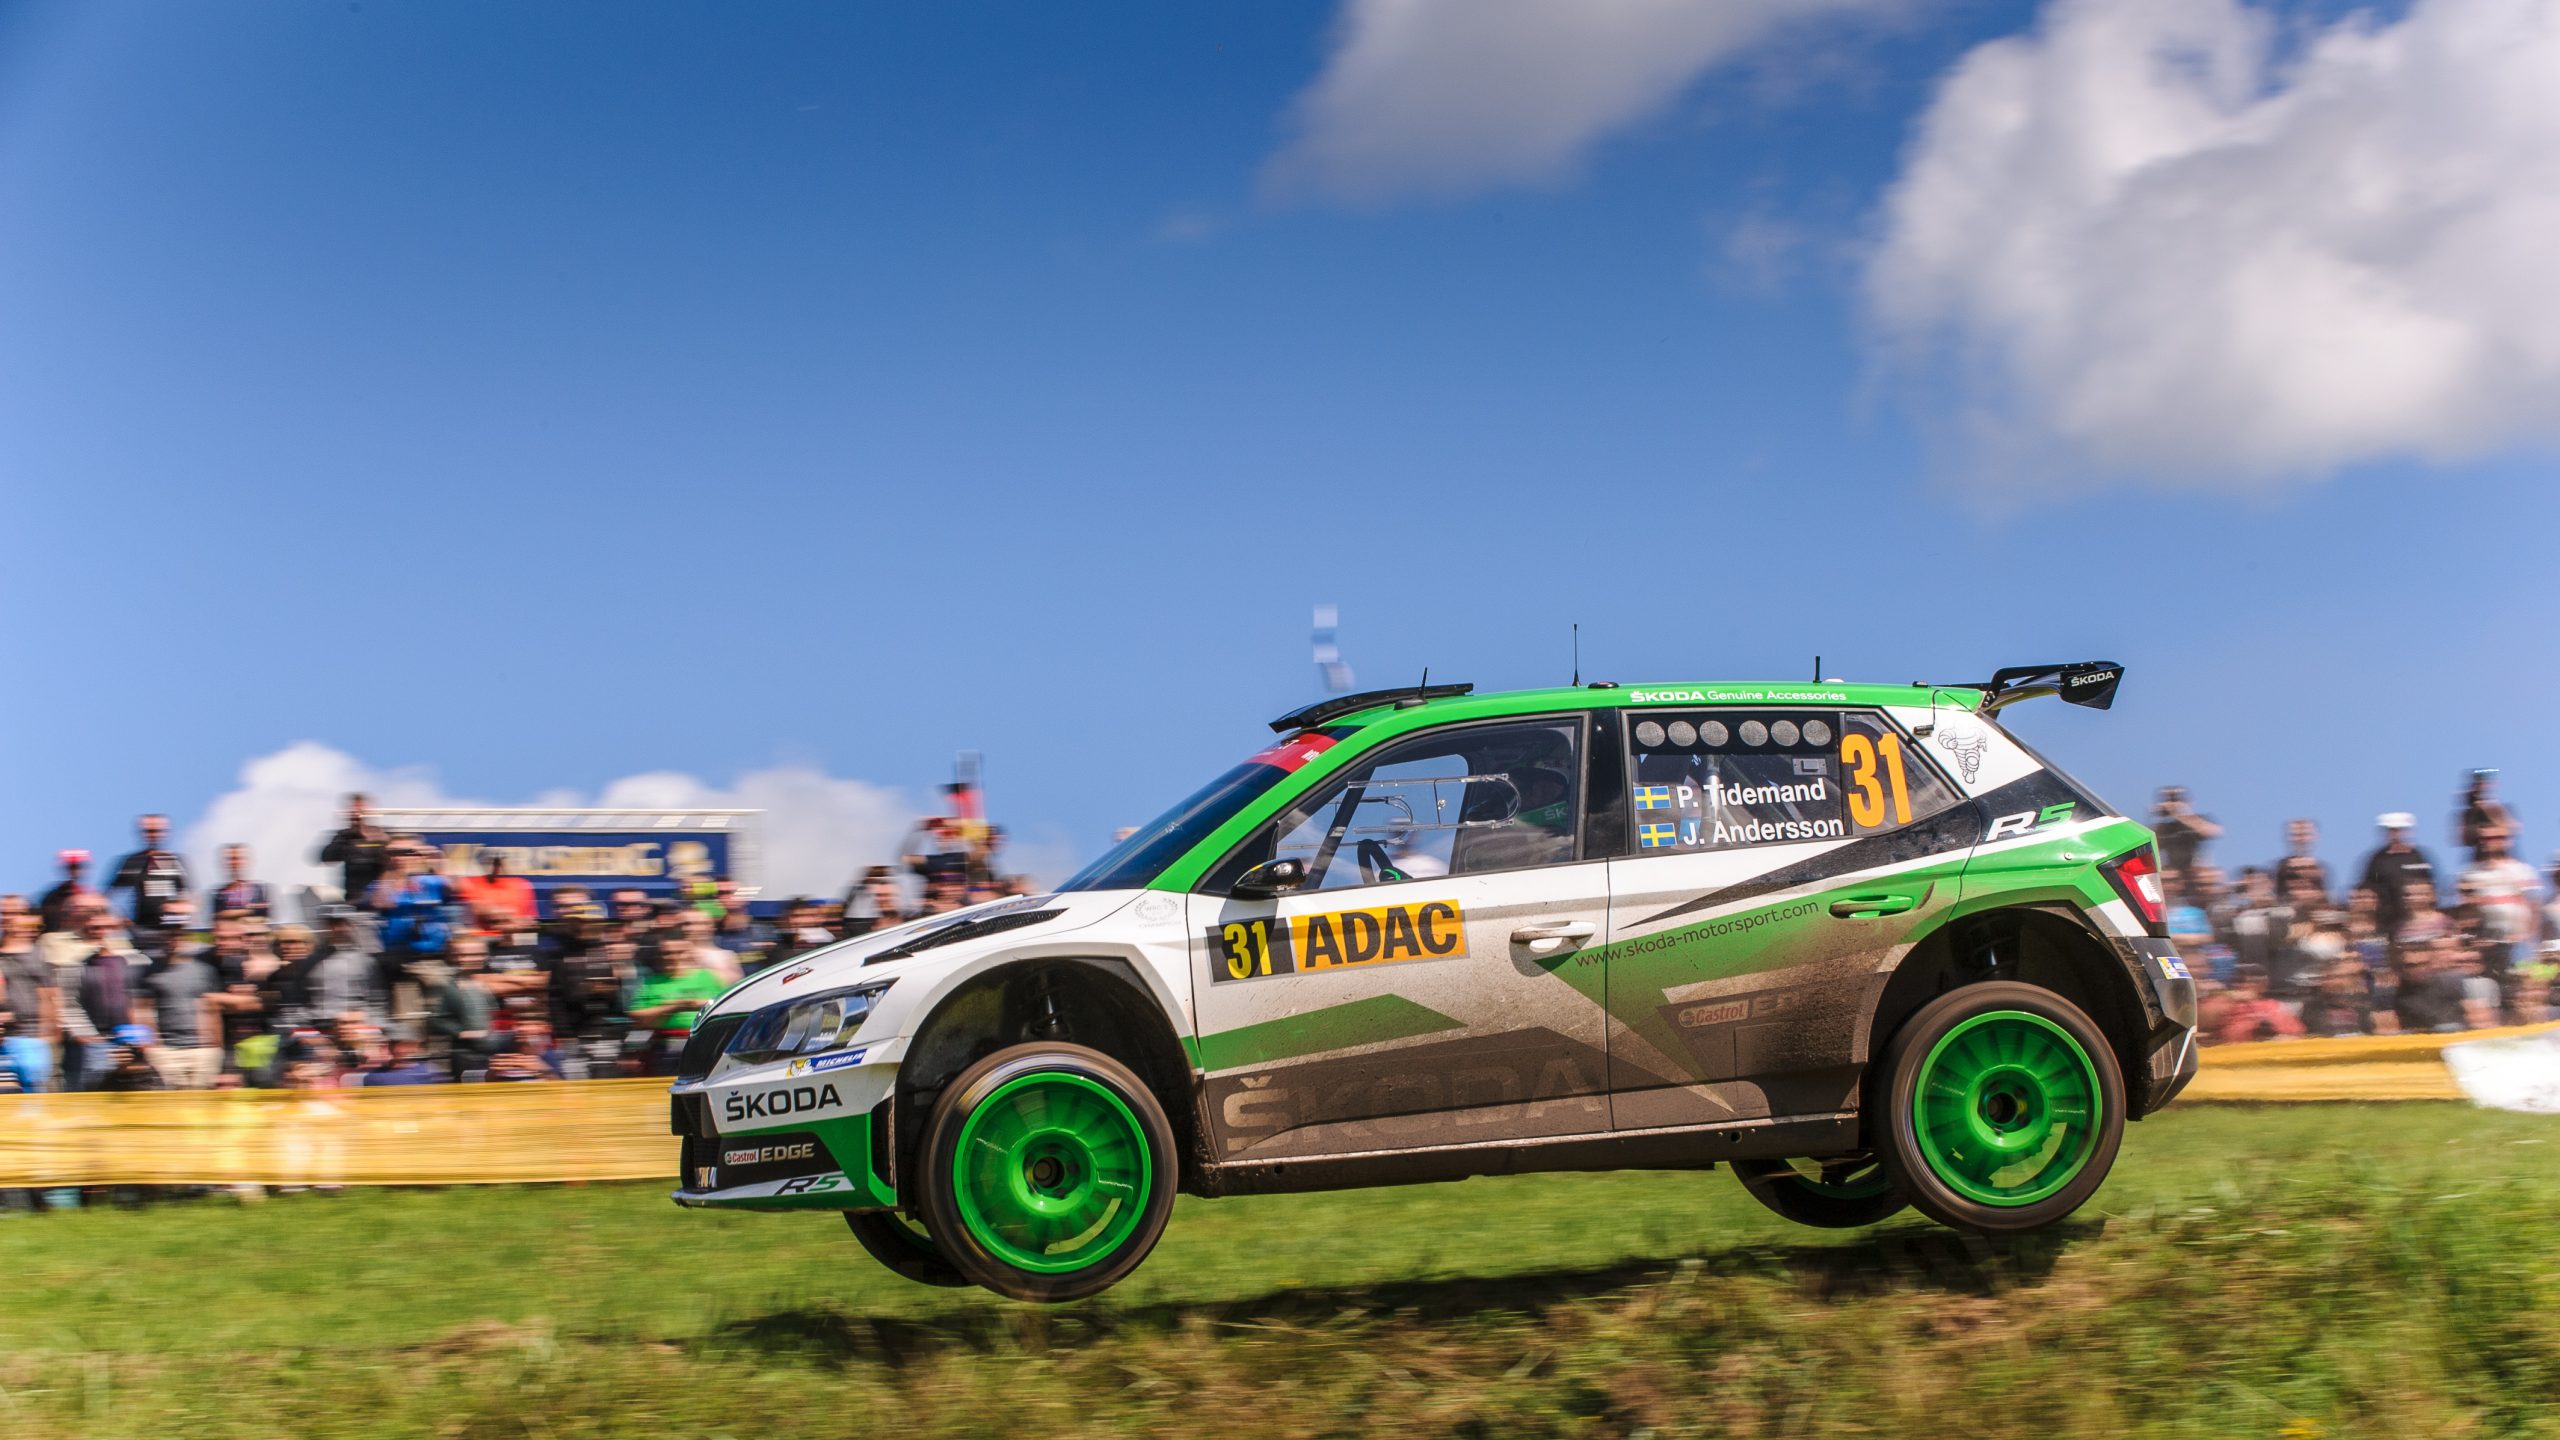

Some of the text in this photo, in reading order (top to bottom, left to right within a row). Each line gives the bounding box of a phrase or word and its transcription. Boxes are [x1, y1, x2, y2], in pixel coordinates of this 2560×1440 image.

[2070, 671, 2114, 687] ŠKODA
[1630, 690, 1847, 703] ŠKODA Genuine Accessories
[1676, 777, 1827, 809] P. Tidemand
[1841, 731, 1913, 828] 31
[1683, 818, 1844, 846] J. Andersson
[1985, 801, 2076, 842] R5
[1223, 902, 1458, 979] 31 ADAC
[1575, 901, 1819, 968] www.skoda-motorsport.com
[1696, 1003, 1745, 1024] Castrol
[815, 1052, 865, 1069] MICHELIN
[725, 1083, 843, 1122] ŠKODA
[1223, 1056, 1604, 1152] ŠKODA
[760, 1142, 815, 1163] EDGE
[774, 1175, 847, 1196] R5
